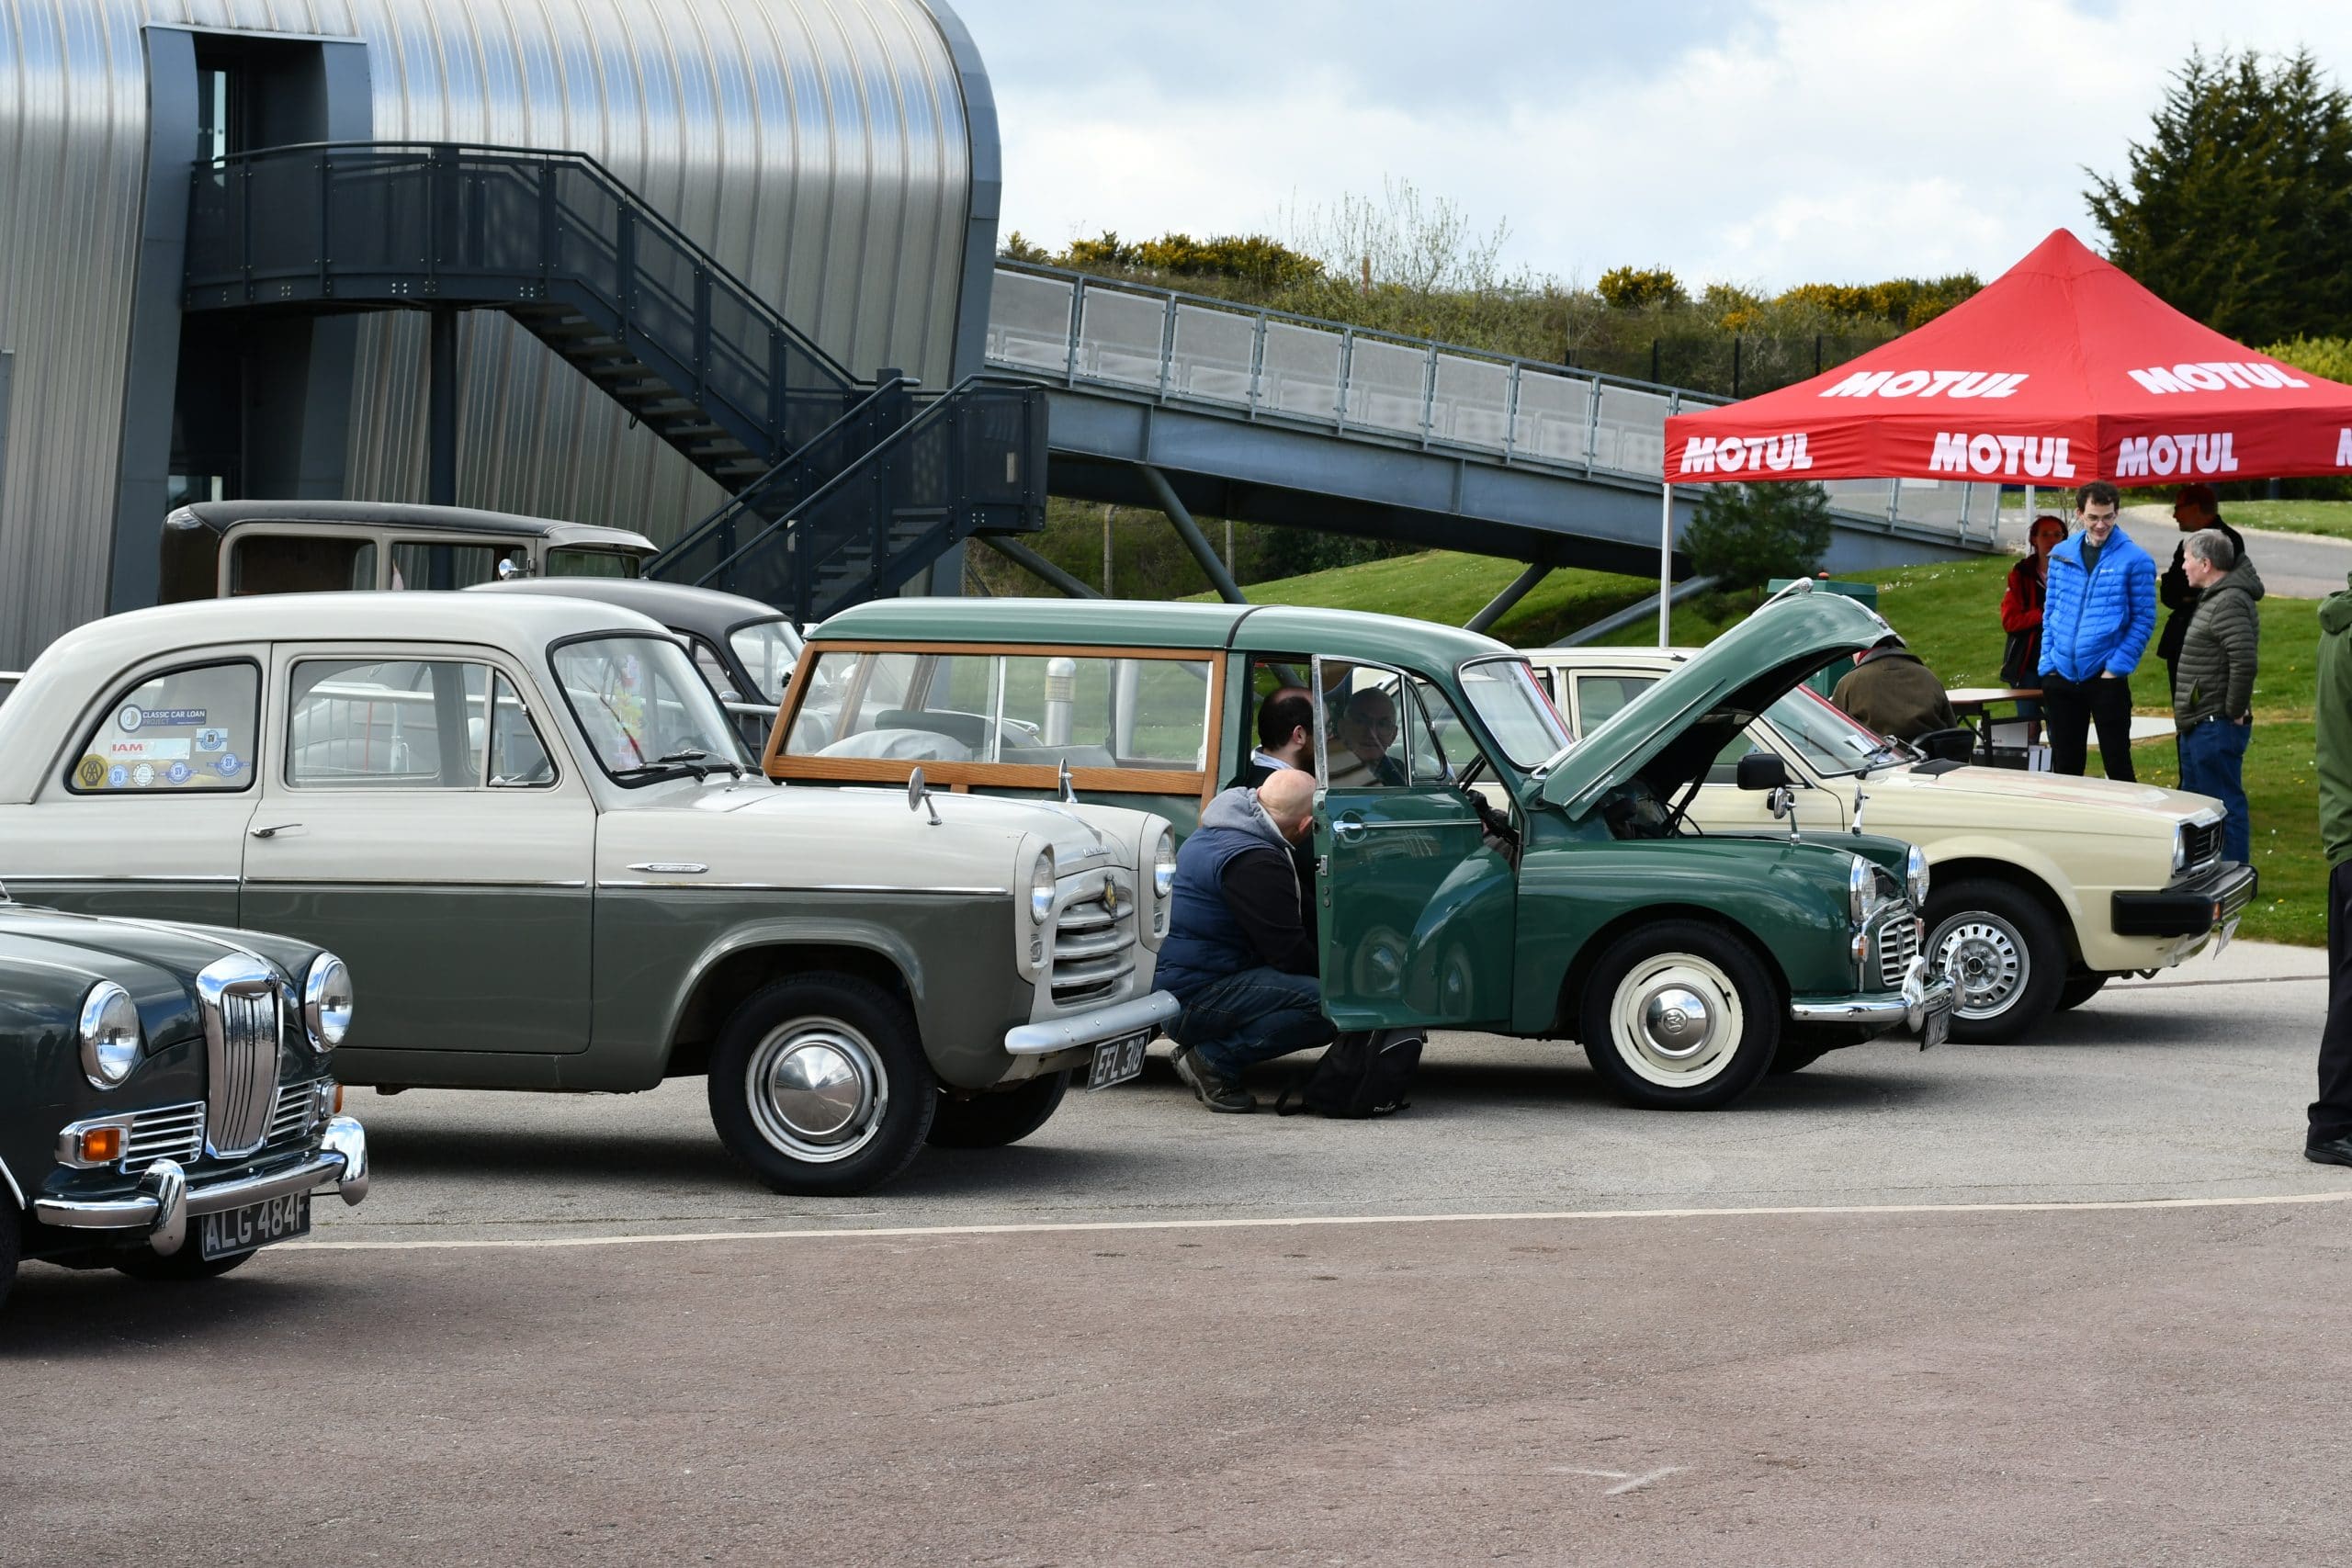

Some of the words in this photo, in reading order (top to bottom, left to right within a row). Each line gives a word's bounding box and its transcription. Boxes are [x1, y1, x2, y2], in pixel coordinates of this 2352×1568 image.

[1818, 370, 2029, 399] MOTUL
[2126, 362, 2311, 395] MOTUL
[1679, 434, 1813, 473] MOTUL
[1928, 432, 2075, 479] MOTUL
[2115, 433, 2239, 477] MOTUL
[111, 743, 143, 751] IAM
[1094, 1043, 1120, 1084] EFL
[1121, 1036, 1145, 1075] 318
[206, 1205, 253, 1252] ALG
[257, 1193, 306, 1238] 484F
